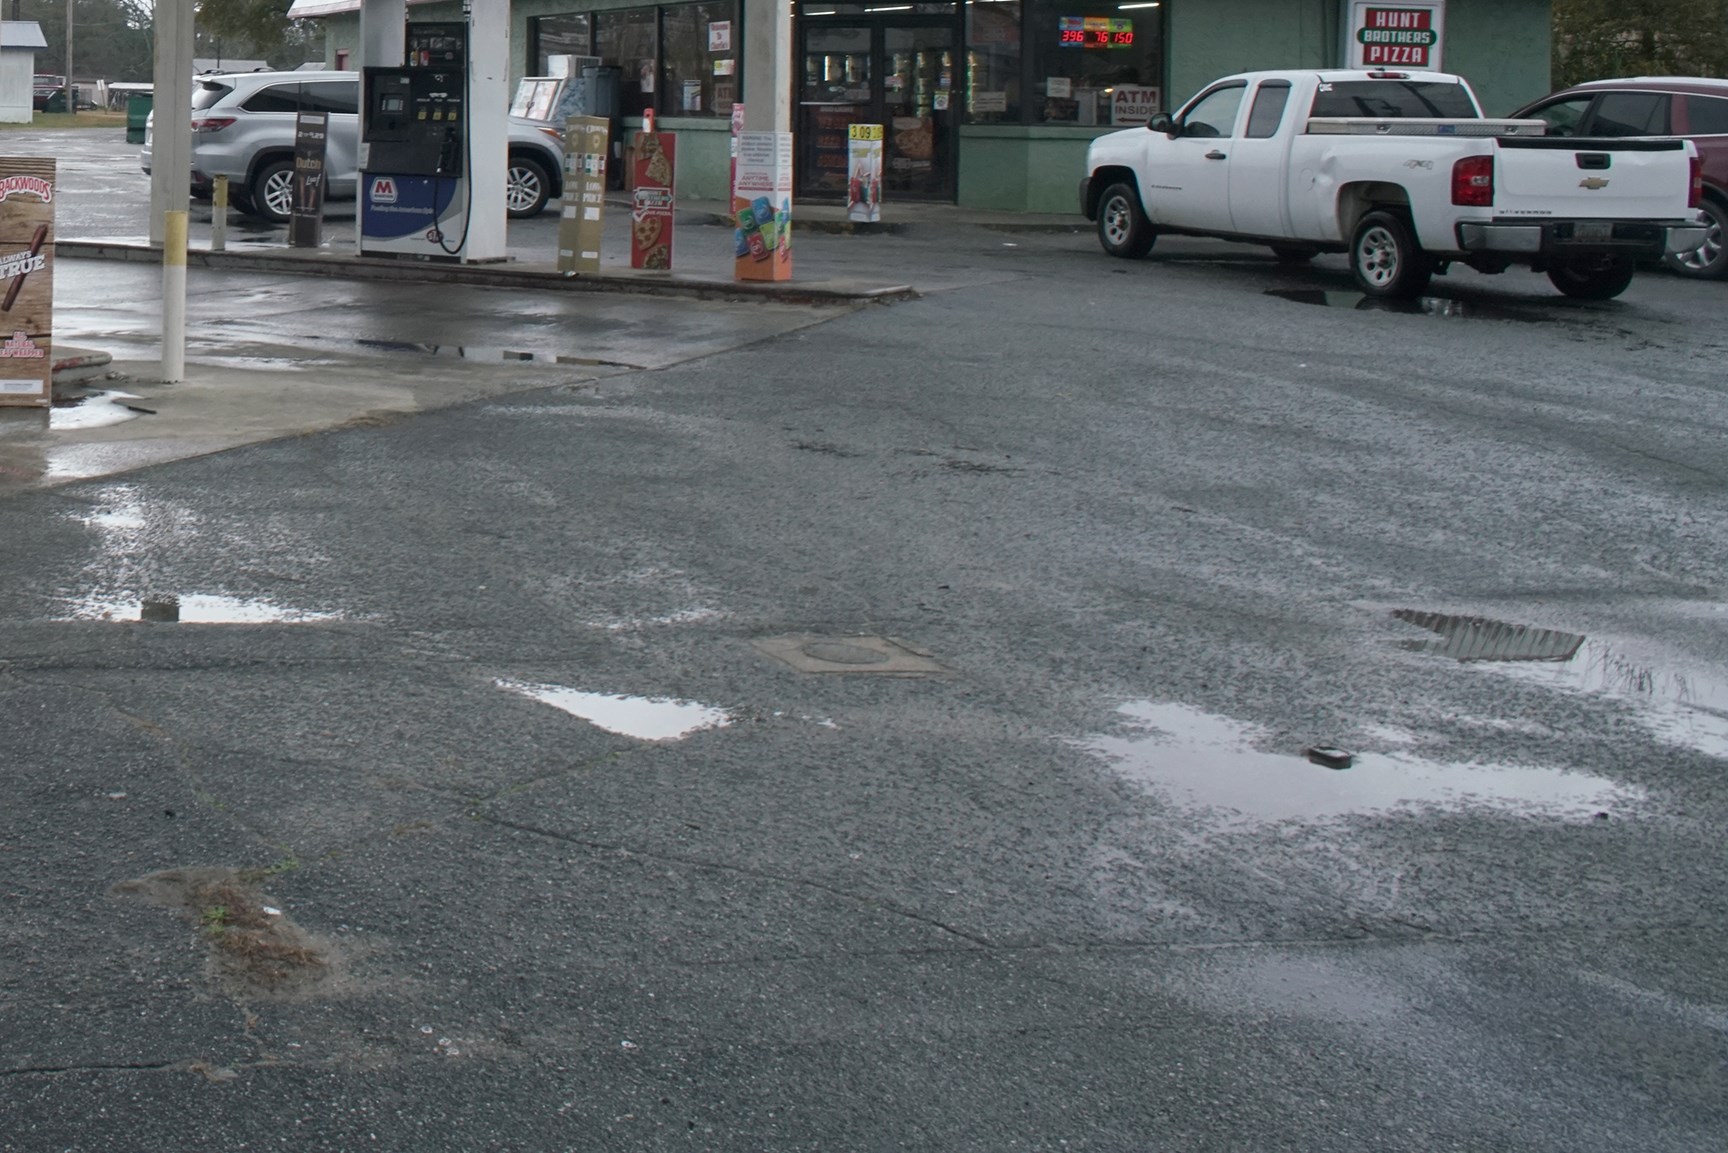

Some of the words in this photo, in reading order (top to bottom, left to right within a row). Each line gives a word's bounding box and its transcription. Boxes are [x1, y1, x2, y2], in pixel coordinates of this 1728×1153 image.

[1376, 11, 1421, 28] HUNT
[1061, 30, 1084, 42] 396
[1095, 31, 1109, 43] 76
[1114, 32, 1134, 44] 150
[1364, 29, 1431, 44] BROTHERS
[1370, 46, 1422, 62] PIZZA
[1115, 90, 1157, 104] ATM
[1114, 105, 1157, 116] INSIDE
[296, 156, 322, 169] Dutch
[375, 181, 392, 194] M
